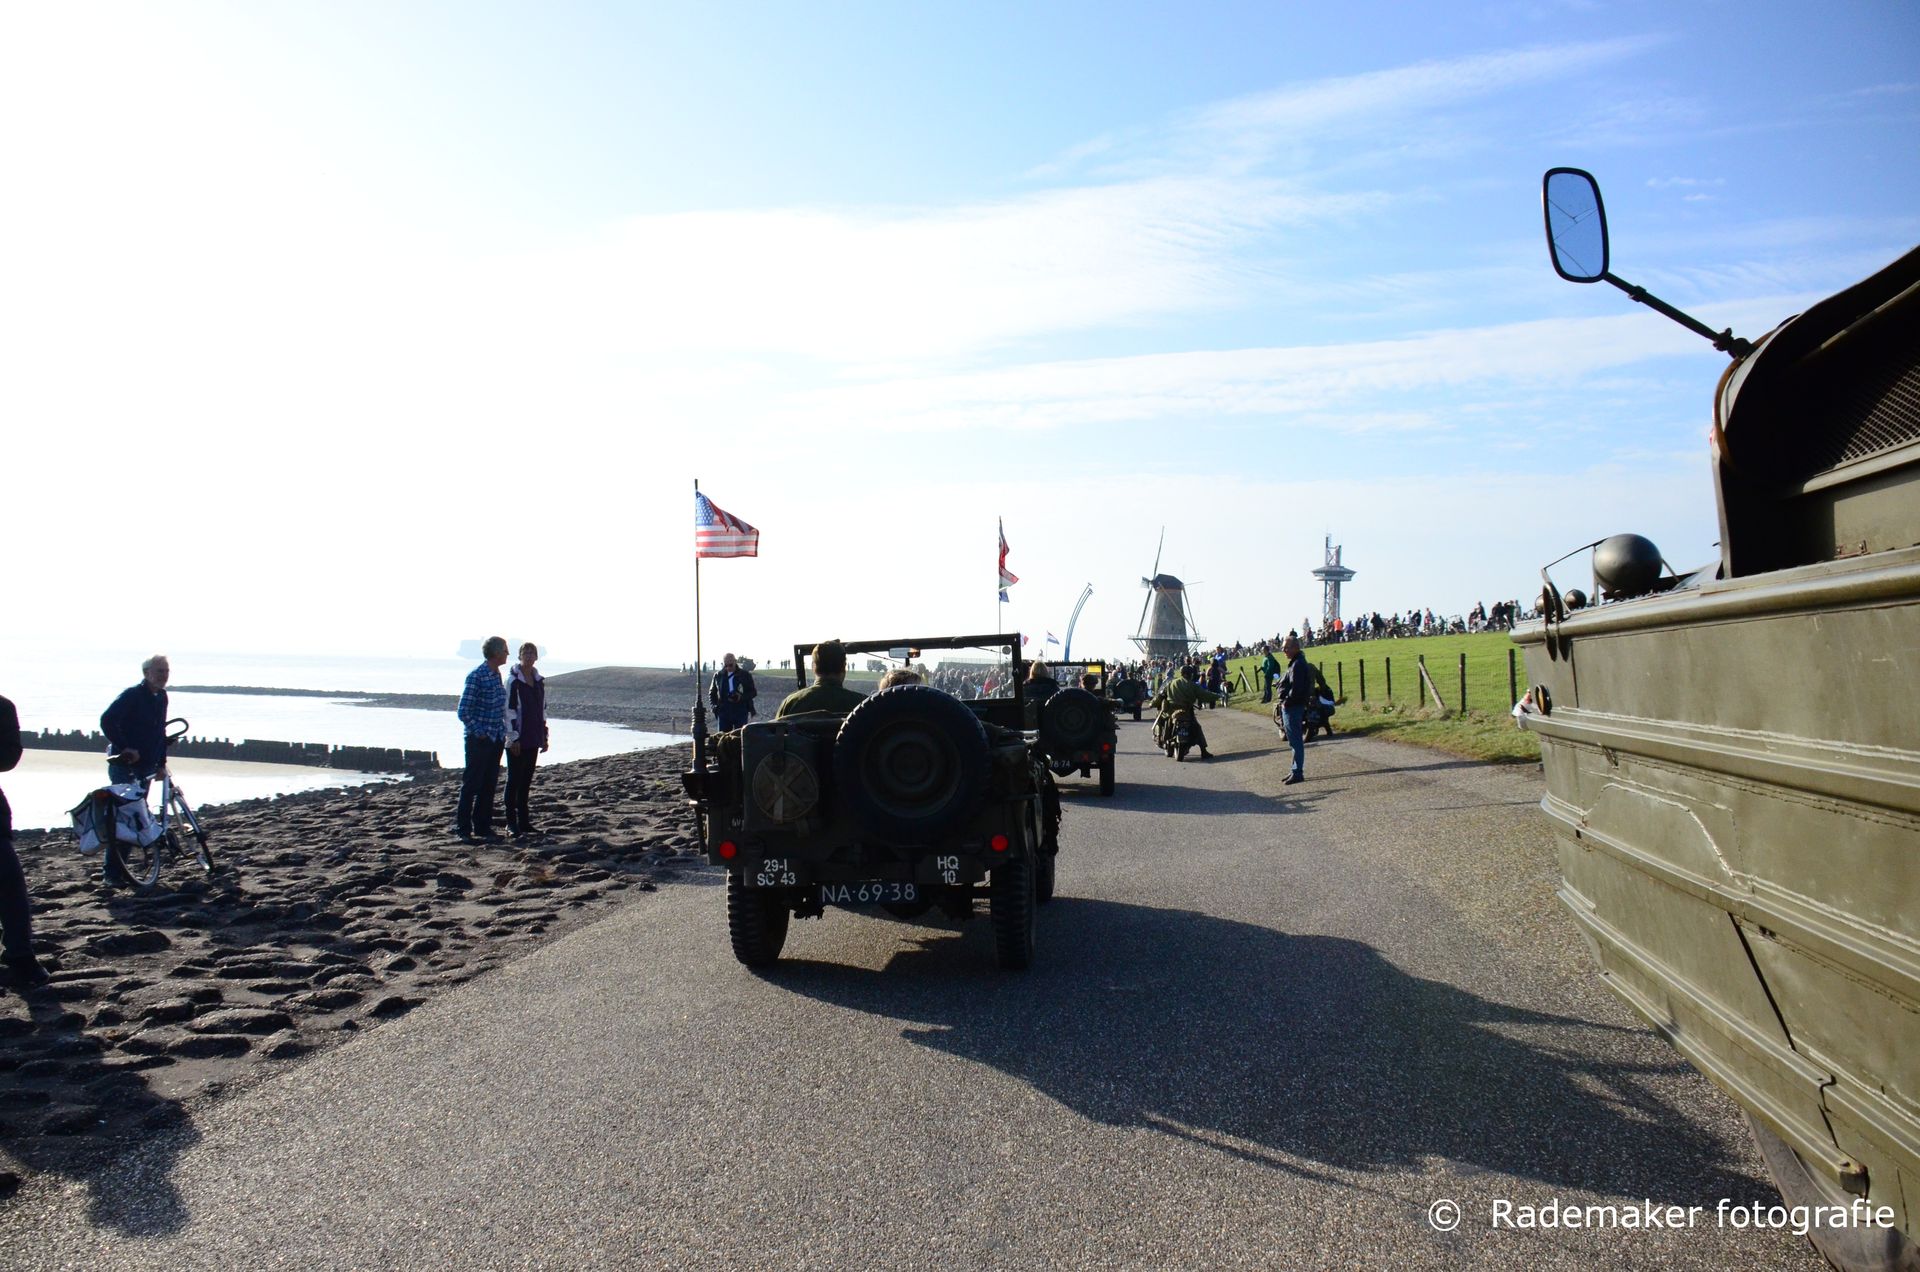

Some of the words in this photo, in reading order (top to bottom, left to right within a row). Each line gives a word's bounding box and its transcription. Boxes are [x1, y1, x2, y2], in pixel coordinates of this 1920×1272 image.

[937, 856, 960, 871] HQ
[756, 872, 775, 887] SC
[780, 872, 797, 886] 43
[941, 870, 956, 884] 10
